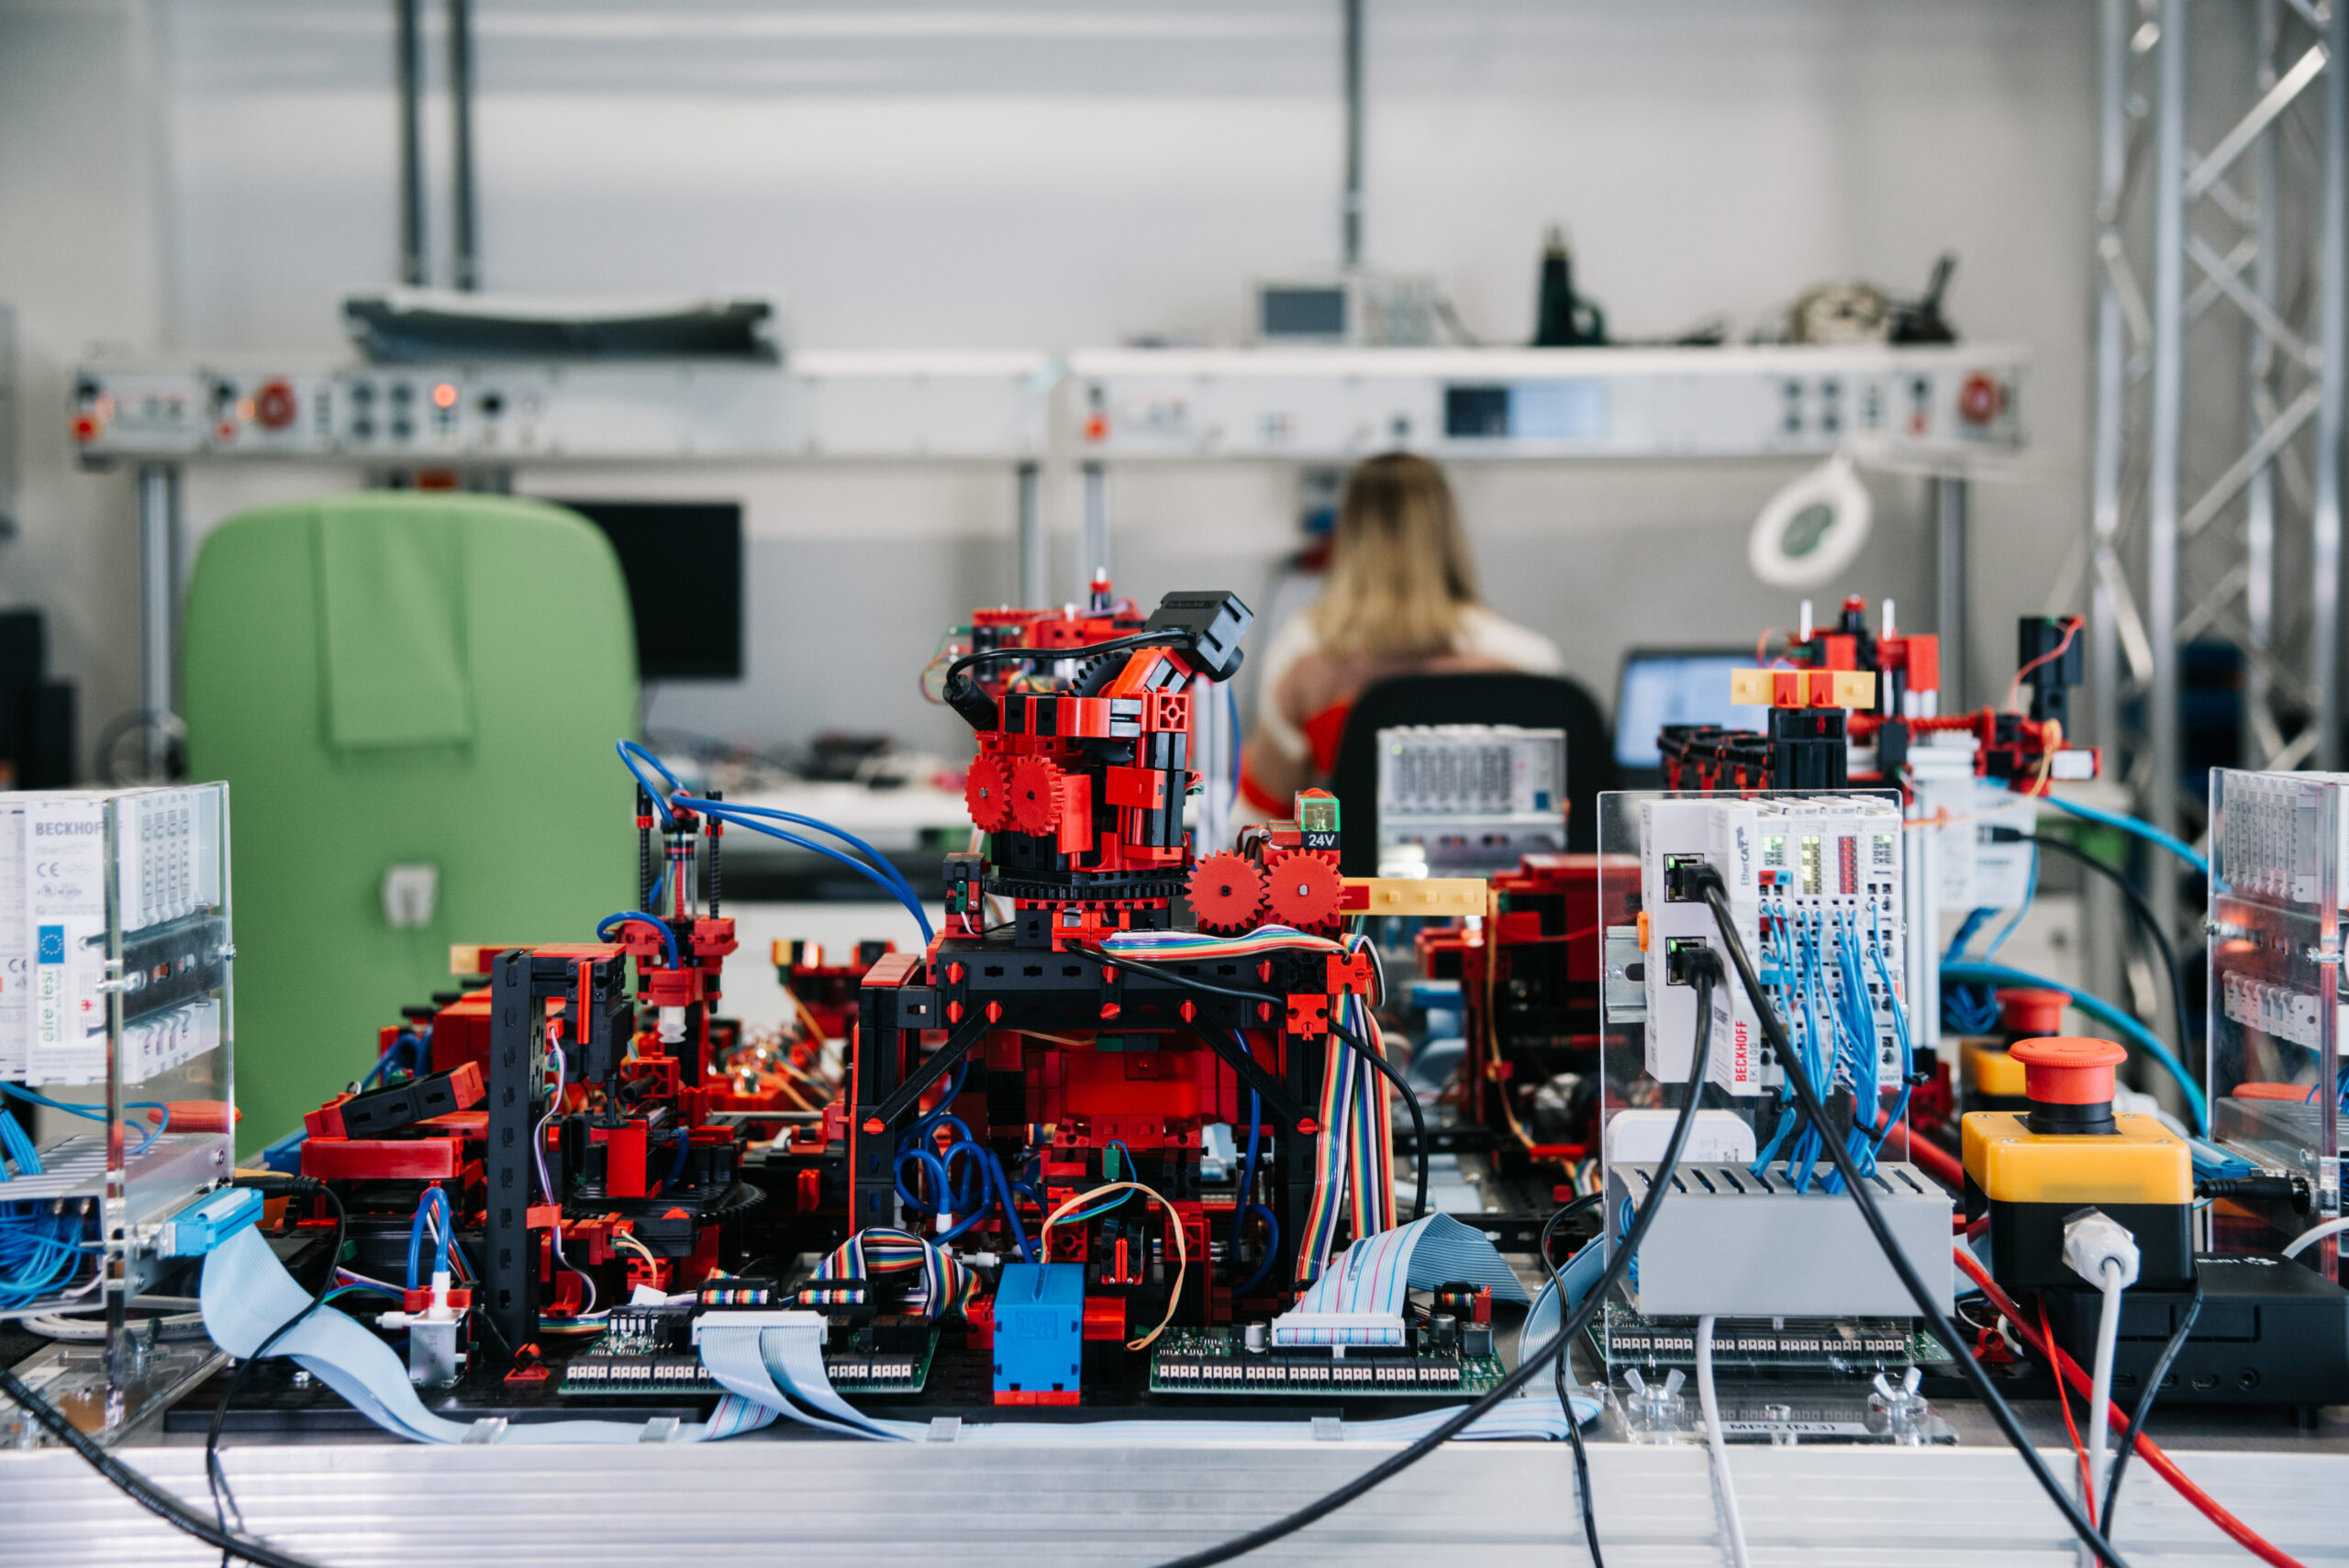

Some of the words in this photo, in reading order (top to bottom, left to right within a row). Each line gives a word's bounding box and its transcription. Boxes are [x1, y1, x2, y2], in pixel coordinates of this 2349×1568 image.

[1308, 834, 1335, 847] 24V
[1735, 1020, 1747, 1082] BECKHOFF
[1749, 1042, 1758, 1083] EK1100
